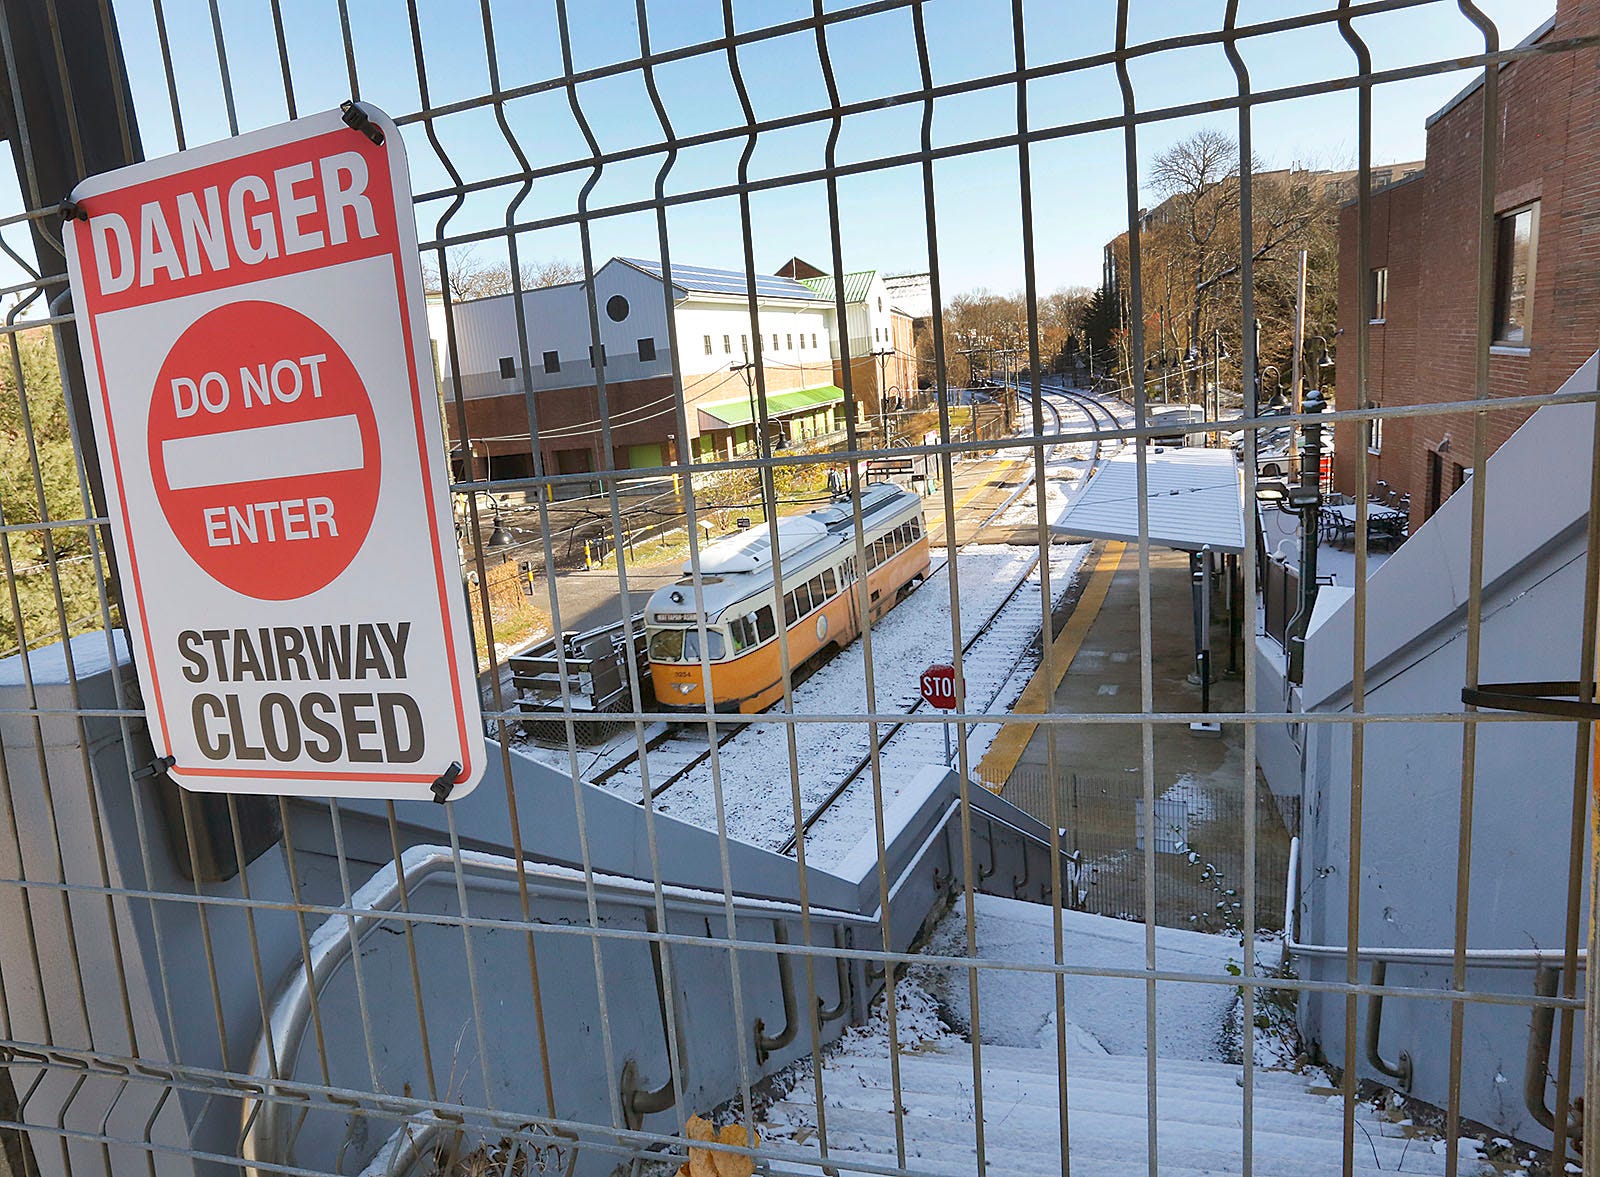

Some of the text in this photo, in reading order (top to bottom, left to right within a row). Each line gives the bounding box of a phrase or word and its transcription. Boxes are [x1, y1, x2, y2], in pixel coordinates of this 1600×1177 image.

[90, 152, 379, 295] DANGER
[171, 354, 326, 418] DO NOT
[204, 497, 339, 546] ENTER
[178, 622, 411, 683] STAIRWAY
[192, 692, 425, 763] CLOSED
